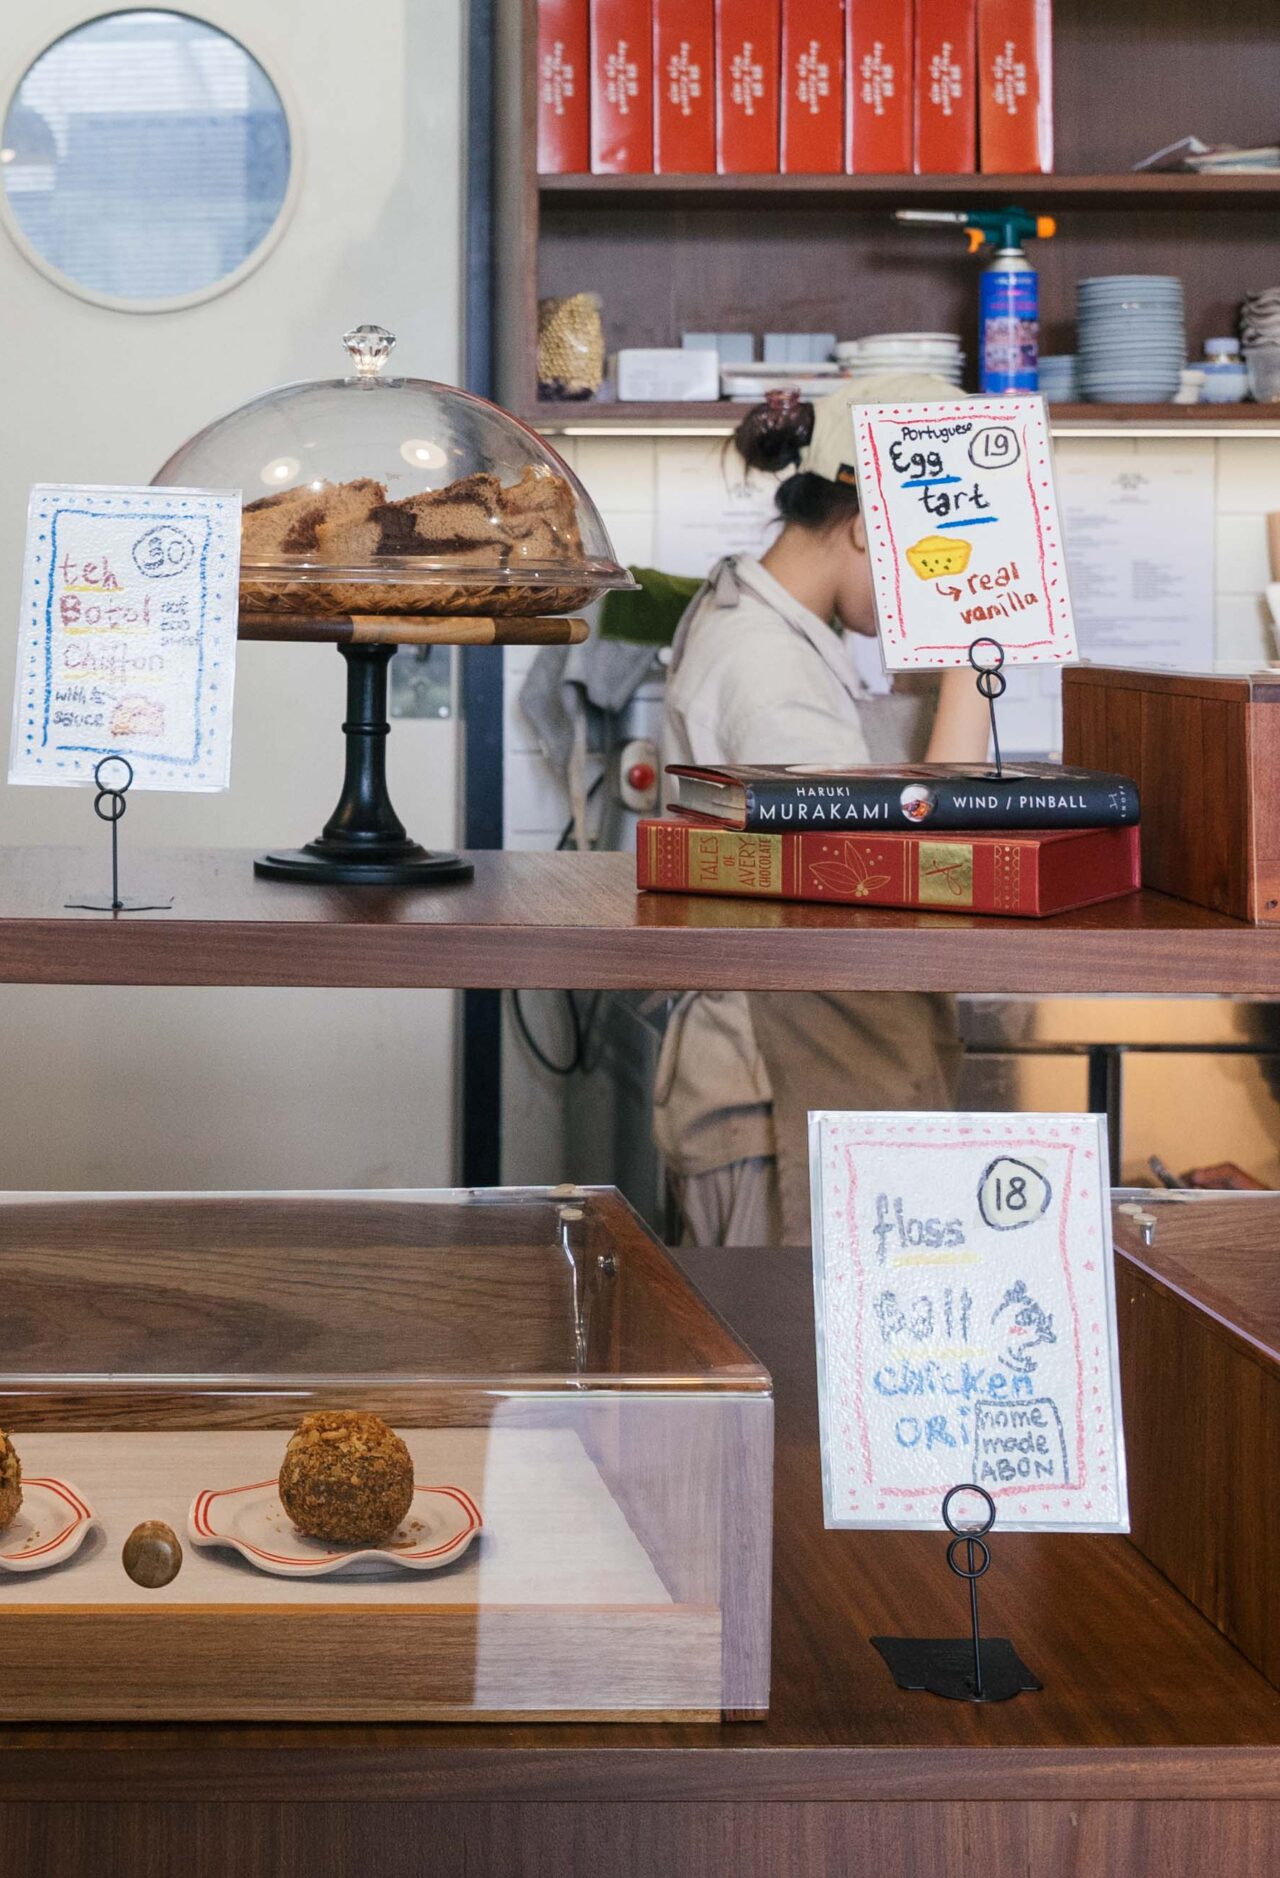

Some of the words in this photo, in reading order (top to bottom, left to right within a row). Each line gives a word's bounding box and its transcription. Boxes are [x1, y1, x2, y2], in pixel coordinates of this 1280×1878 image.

[901, 422, 973, 443] Portuguese
[984, 433, 1009, 457] 19
[889, 441, 943, 479] Egg
[918, 483, 990, 516] tart
[144, 537, 185, 570] 30
[967, 562, 1019, 595] real
[960, 591, 1038, 624] vanilla
[796, 786, 851, 797] HARUKI
[953, 796, 998, 809] WIND
[1020, 795, 1087, 809] PINBALL
[760, 803, 889, 820] MURAKAMI
[700, 836, 719, 882] TALES
[723, 855, 736, 867] OF
[738, 837, 756, 887] AVERY
[759, 838, 772, 888] CHOCOLATE
[995, 1177, 1026, 1211] 18
[982, 1431, 1049, 1455] made
[980, 1457, 1054, 1482] ABON
